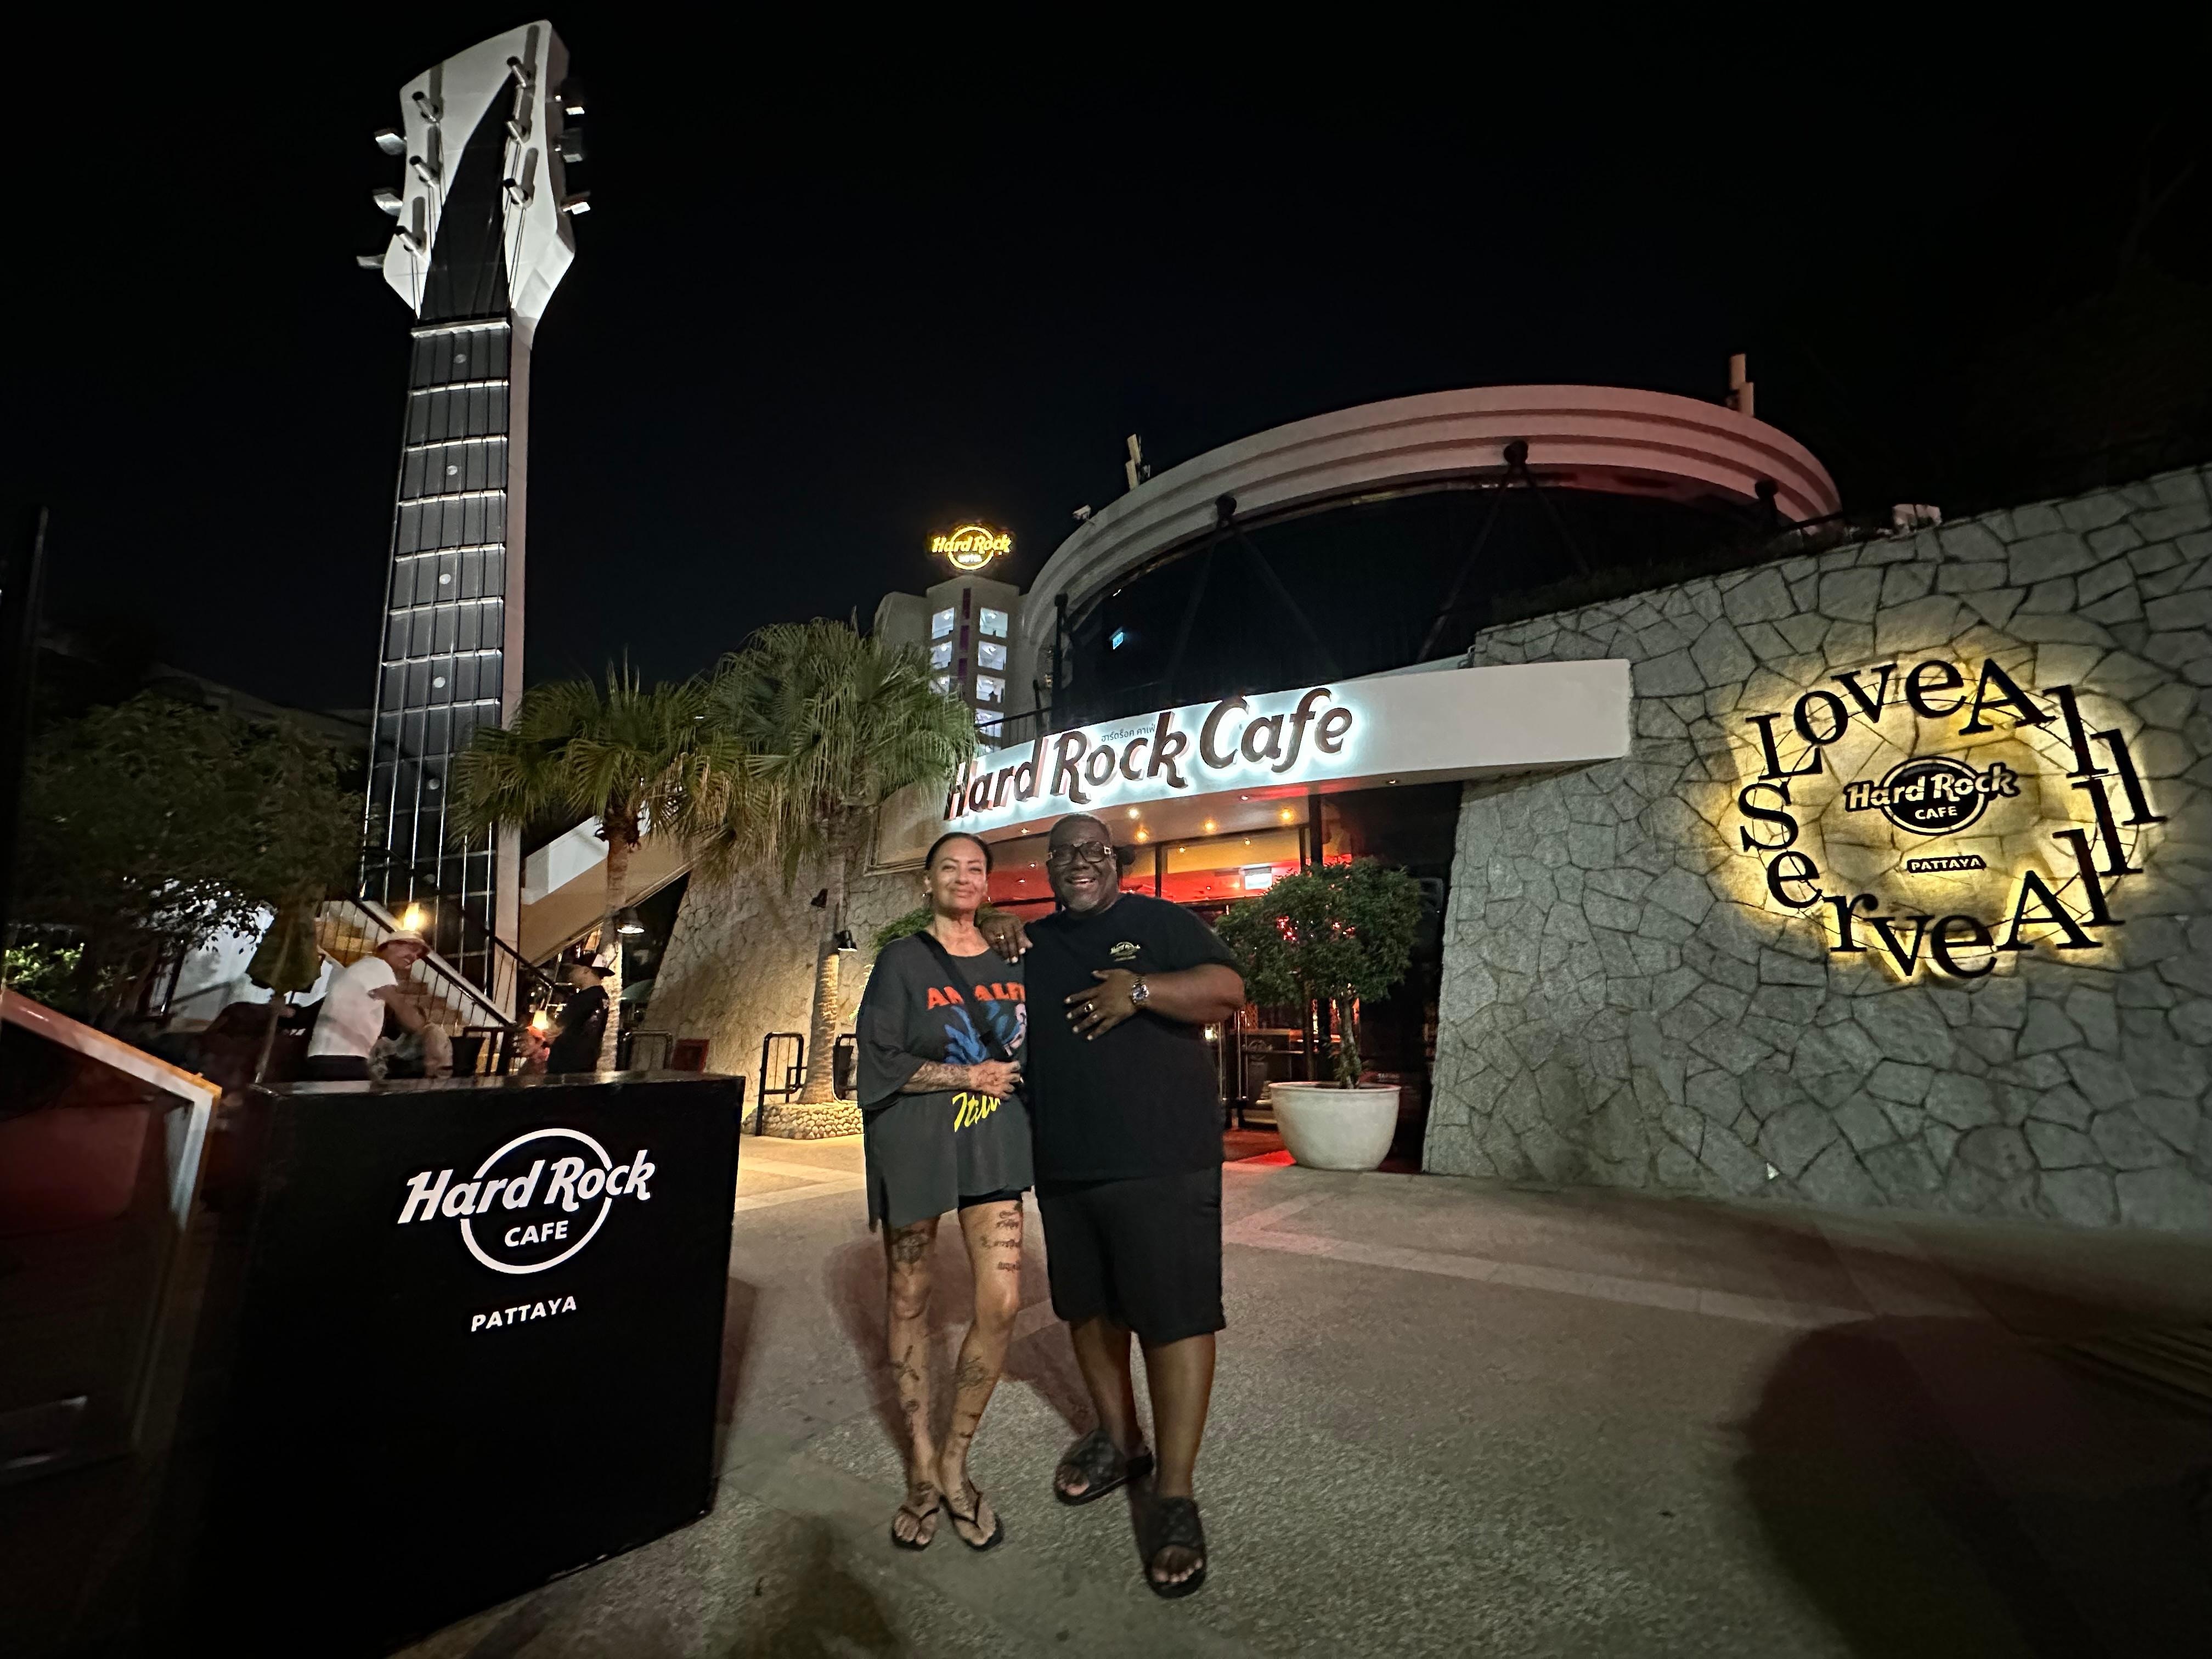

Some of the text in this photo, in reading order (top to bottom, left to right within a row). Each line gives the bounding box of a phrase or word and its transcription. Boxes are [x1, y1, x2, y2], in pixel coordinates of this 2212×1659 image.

[932, 534, 1012, 555] Hard Rock
[1050, 711, 1189, 804] Rock
[1199, 687, 1353, 774] Cafe
[1745, 657, 2169, 825] Love All
[1846, 765, 2018, 809] Hard Rock
[1915, 806, 1958, 820] CAFE
[1738, 779, 2143, 979] Serve All
[1910, 857, 1982, 871] PATTAYA
[397, 1149, 656, 1224] Hard Rock
[504, 1220, 569, 1248] CAFE
[470, 1295, 577, 1332] PATTAYA
